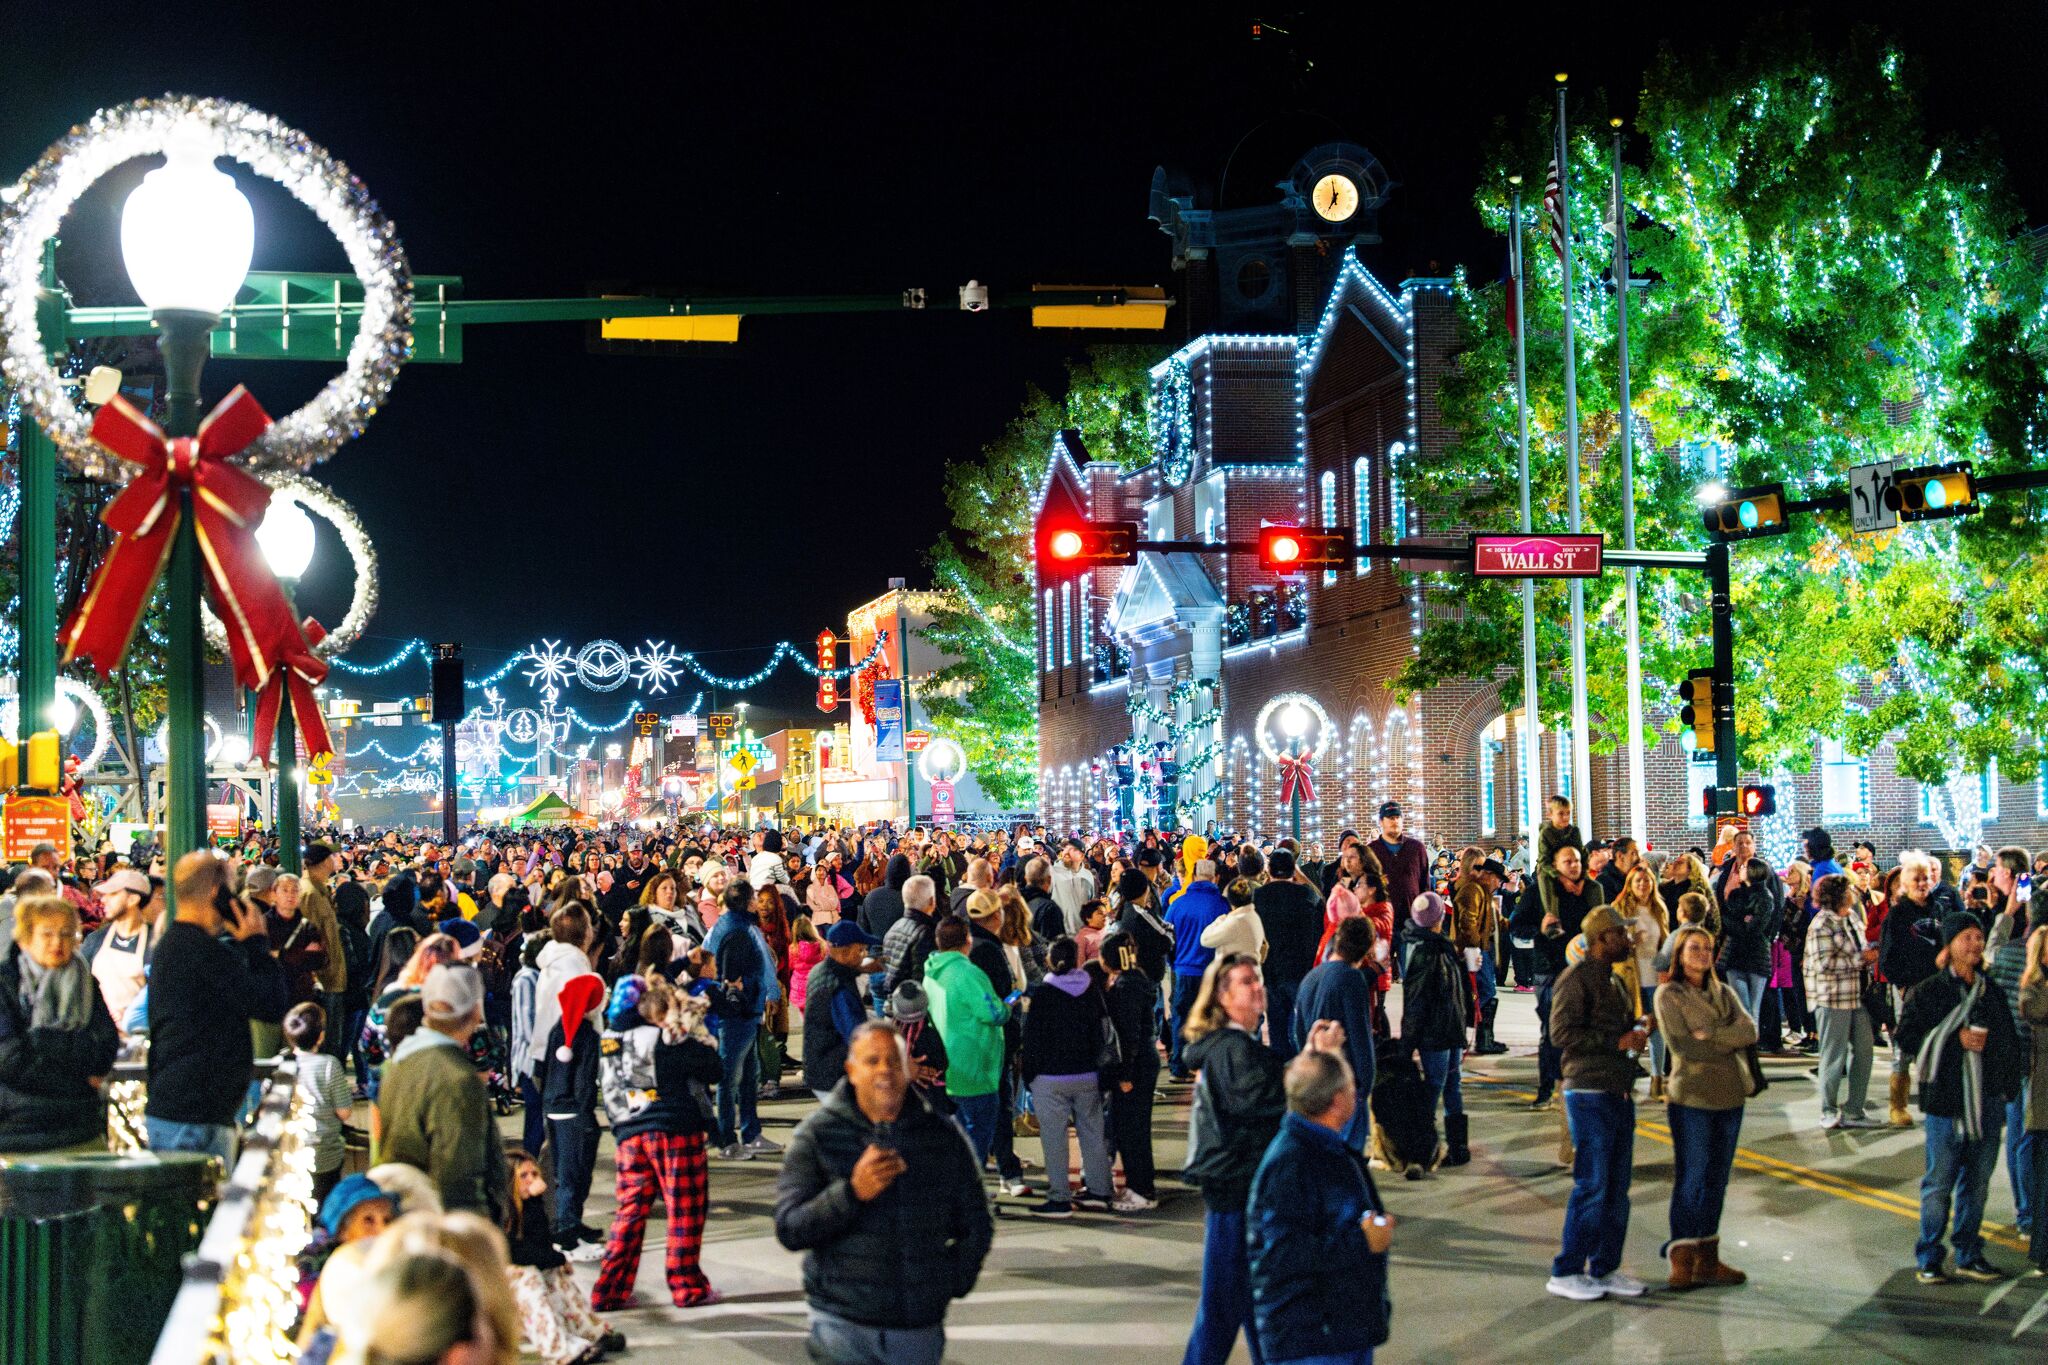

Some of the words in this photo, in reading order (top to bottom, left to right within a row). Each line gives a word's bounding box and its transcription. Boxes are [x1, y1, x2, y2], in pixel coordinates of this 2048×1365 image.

[1855, 516, 1874, 528] ONLY
[1500, 552, 1549, 570] WALL
[1553, 552, 1577, 570] ST
